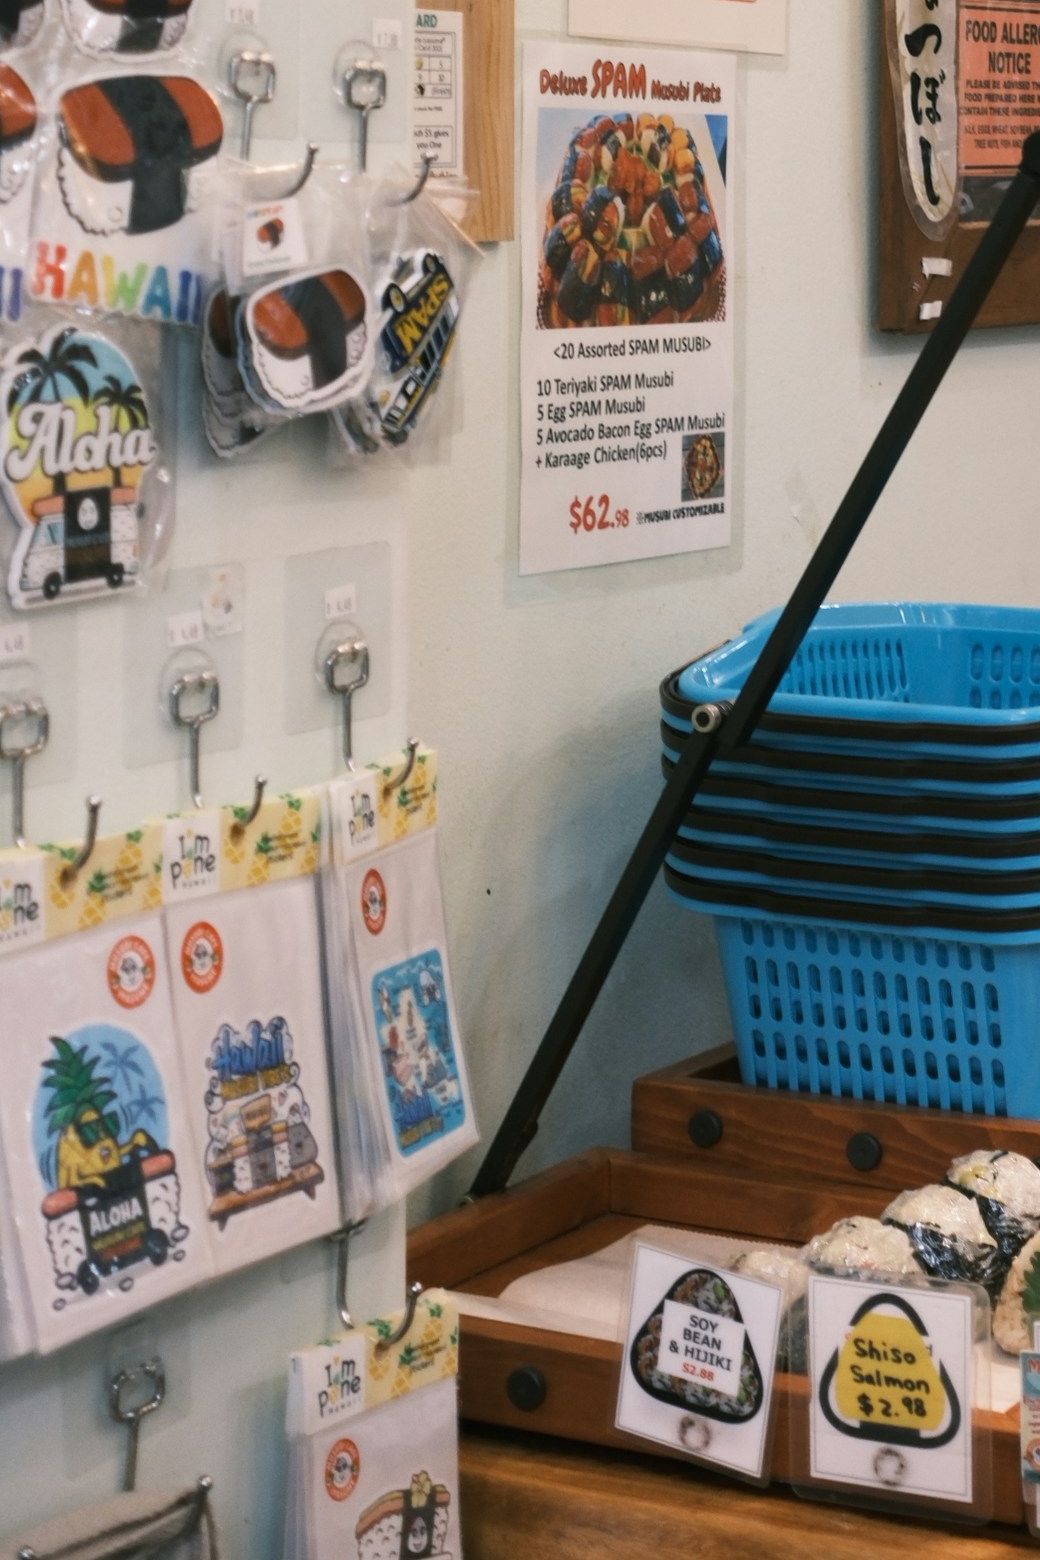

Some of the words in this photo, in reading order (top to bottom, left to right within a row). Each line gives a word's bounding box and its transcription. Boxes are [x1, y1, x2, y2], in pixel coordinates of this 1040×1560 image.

[965, 19, 997, 44] FOOD
[988, 51, 1031, 76] NOTICE
[539, 68, 588, 96] Deluxe
[591, 58, 647, 102] SPAM
[651, 79, 690, 103] Musubi
[693, 80, 722, 104] Plate
[966, 79, 991, 90] PLEASE
[1002, 81, 1030, 91] ADVISED
[964, 93, 983, 103] FOOD
[984, 94, 1017, 104] PREPARED
[1018, 94, 1036, 104] HERE
[553, 342, 575, 360] <20
[577, 338, 626, 359] Assorted
[629, 338, 660, 356] SPAM
[662, 335, 712, 355] MUSUBI>
[536, 378, 551, 397] 10
[555, 373, 597, 398] Teriyaki
[600, 374, 632, 393] SPAM
[634, 370, 675, 390] Musubi
[537, 404, 544, 422] 5
[547, 402, 567, 423] Egg
[569, 399, 602, 418] SPAM
[605, 396, 646, 415] Musubi
[4, 401, 157, 482] Aloha
[536, 428, 544, 446] 5
[545, 424, 595, 445] Avocado
[598, 423, 631, 441] Bacon
[634, 419, 652, 439] Egg
[654, 415, 685, 435] SPAM
[687, 412, 726, 432] Musubi
[545, 450, 590, 471] Karaage
[594, 440, 667, 466] Chicken(6pcs)
[569, 493, 630, 535] $62.98
[672, 502, 725, 522] CUSTOMIZABLE
[89, 1196, 143, 1237] ALOHA
[689, 1314, 719, 1334] SOY
[683, 1328, 721, 1352] BEAN
[854, 1338, 917, 1365] Shiso
[669, 1341, 679, 1354] &
[684, 1347, 732, 1372] HIJIKI
[682, 1362, 715, 1383] $2.88
[850, 1367, 931, 1395] Salmon
[857, 1392, 928, 1419] $2.98
